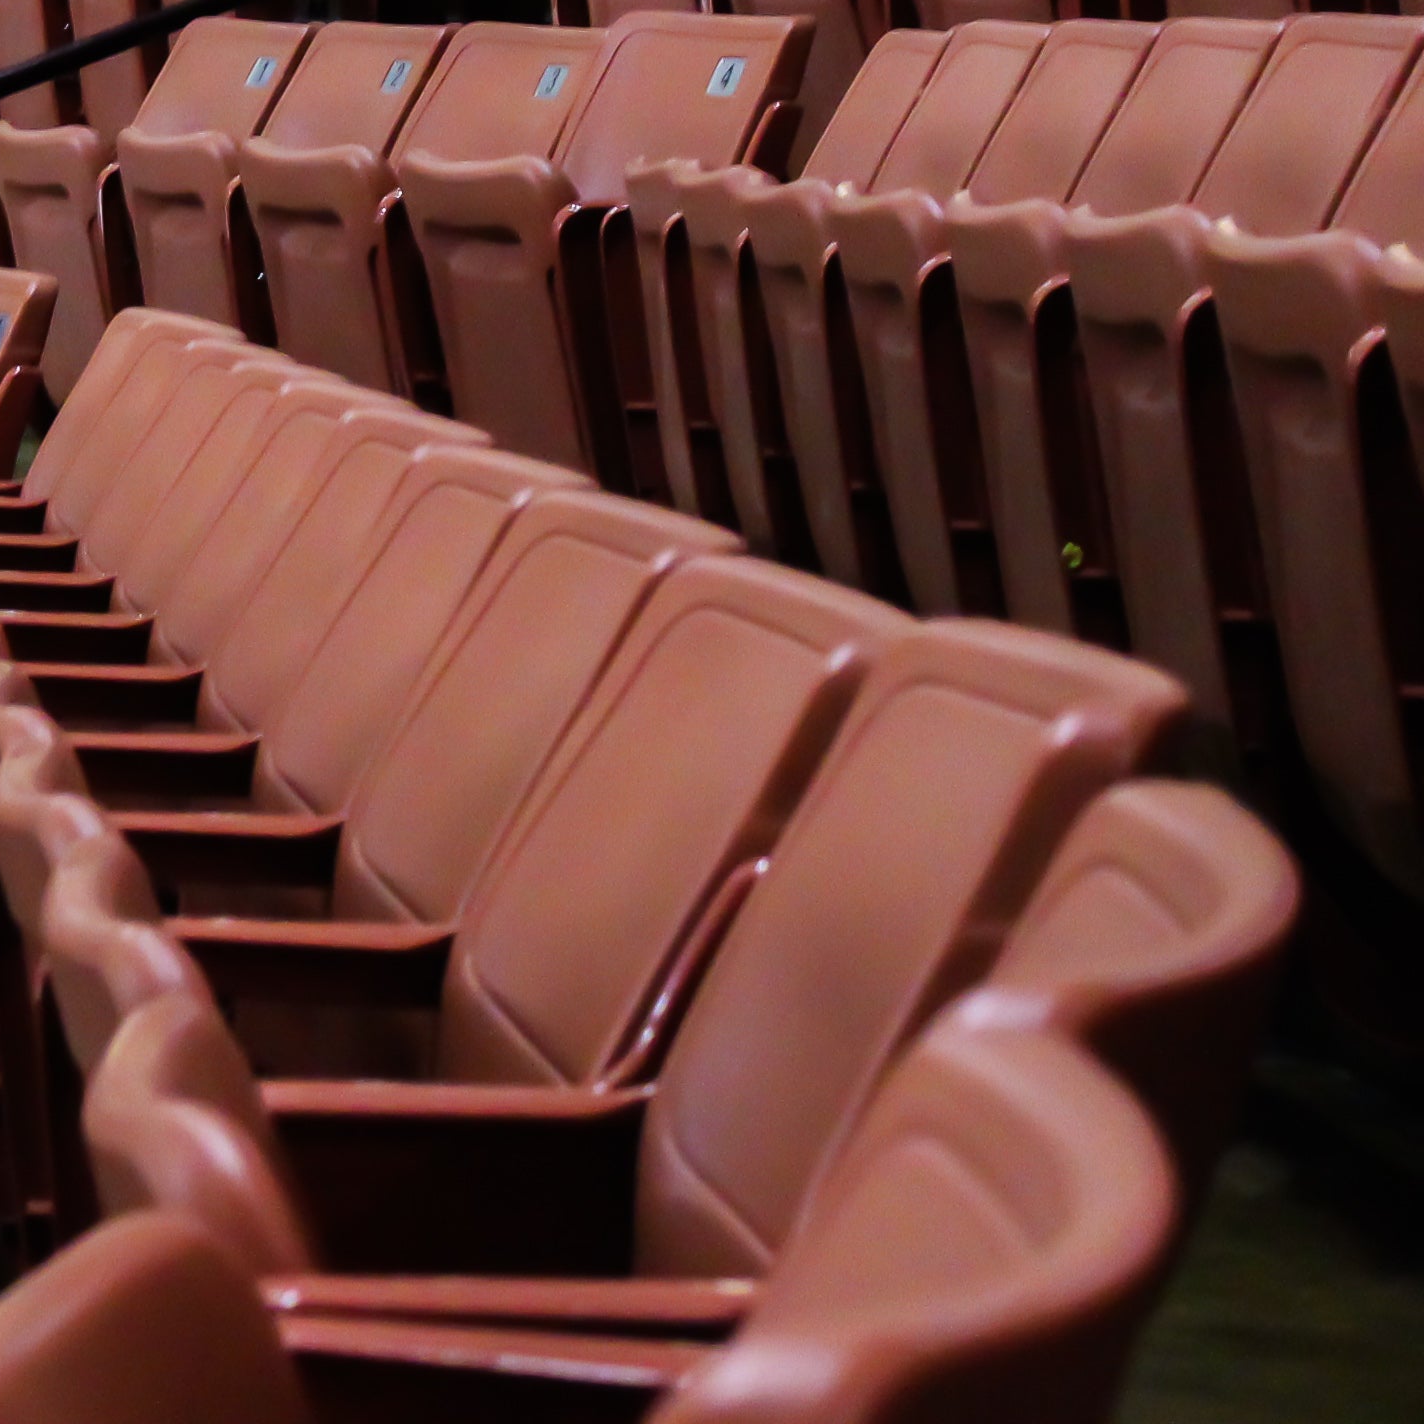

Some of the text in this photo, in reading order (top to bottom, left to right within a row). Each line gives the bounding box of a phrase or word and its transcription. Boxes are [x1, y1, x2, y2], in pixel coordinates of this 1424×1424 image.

[258, 60, 270, 82] 1
[390, 62, 406, 87] 2
[721, 63, 736, 90] 4
